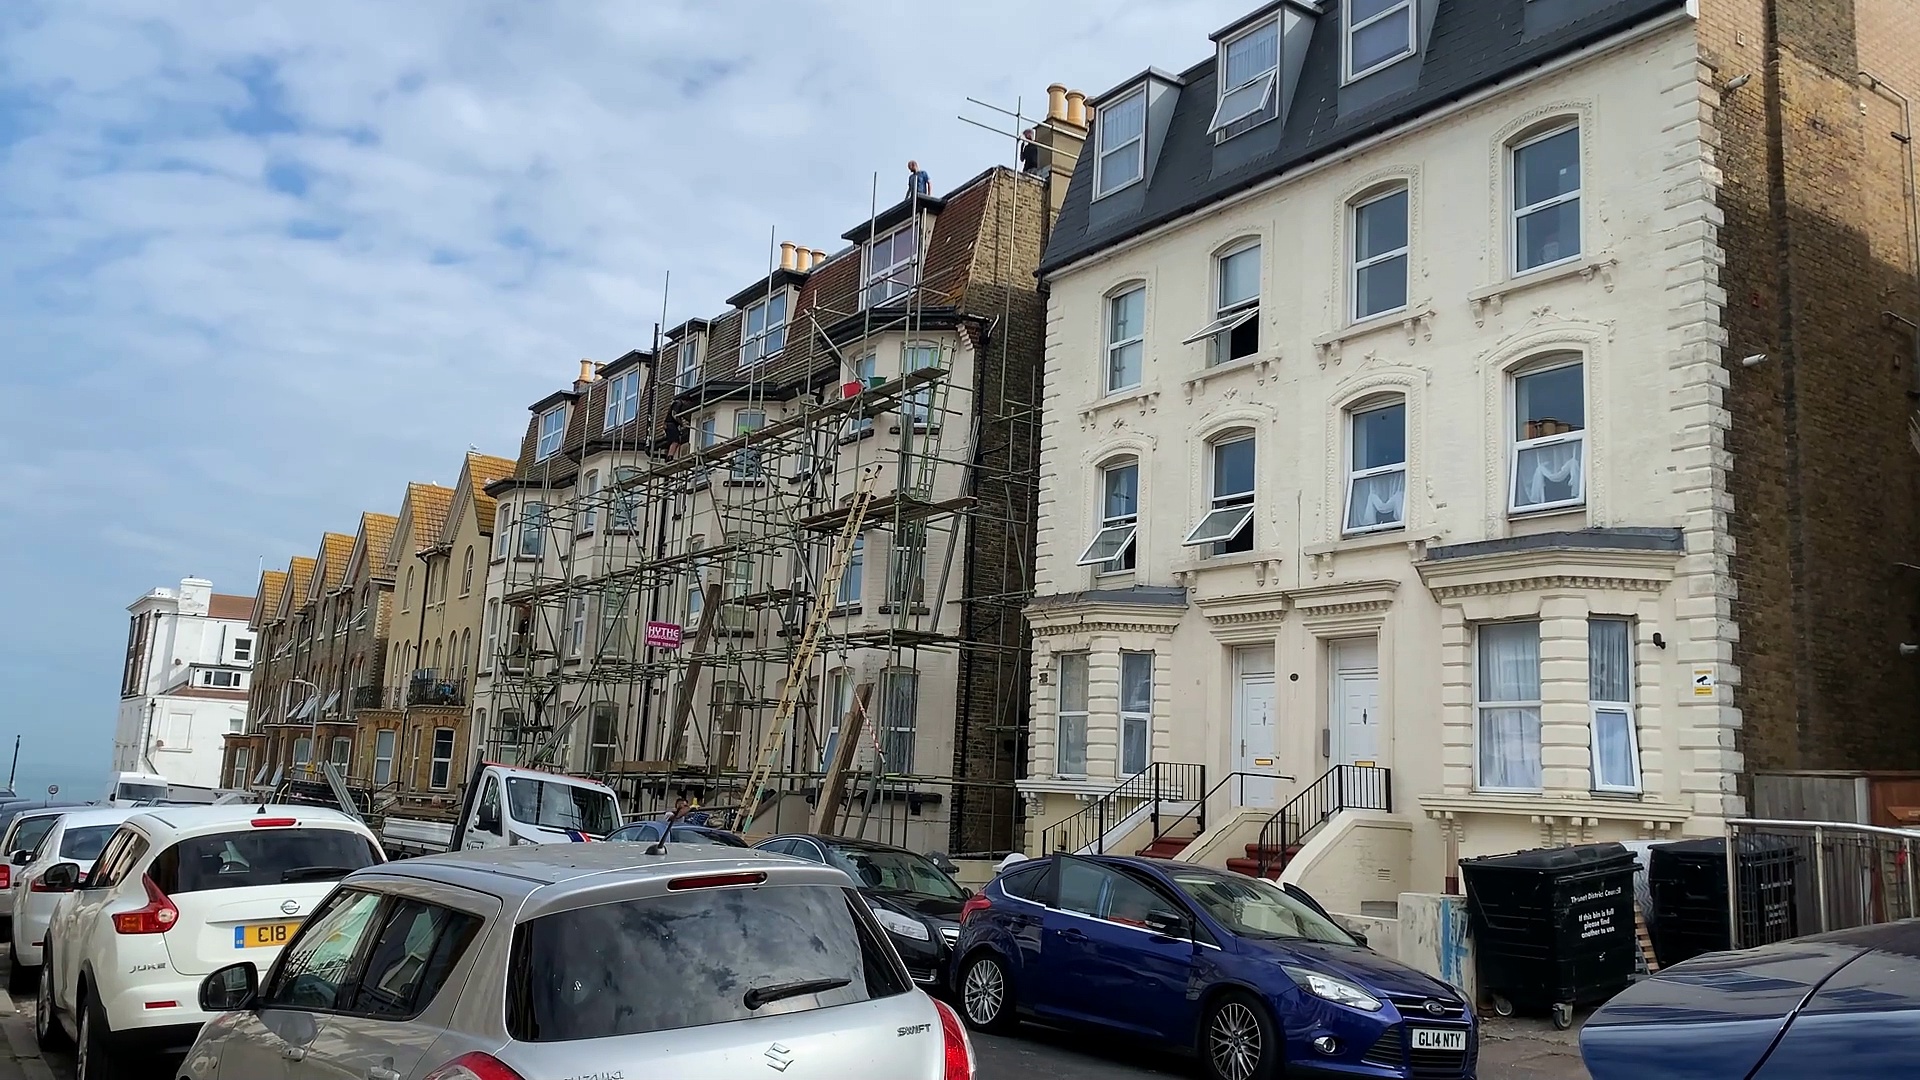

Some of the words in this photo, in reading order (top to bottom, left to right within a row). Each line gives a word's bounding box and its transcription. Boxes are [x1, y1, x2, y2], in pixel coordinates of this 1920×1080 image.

[648, 625, 680, 638] HYTHE
[1583, 913, 1592, 921] this
[1592, 911, 1601, 919] bin
[1606, 907, 1615, 916] full
[1584, 921, 1600, 930] please
[1600, 916, 1610, 925] find
[1581, 928, 1600, 938] another
[129, 962, 166, 974] JUKE
[896, 1023, 931, 1037] SWIFT
[1443, 1033, 1461, 1048] NTY
